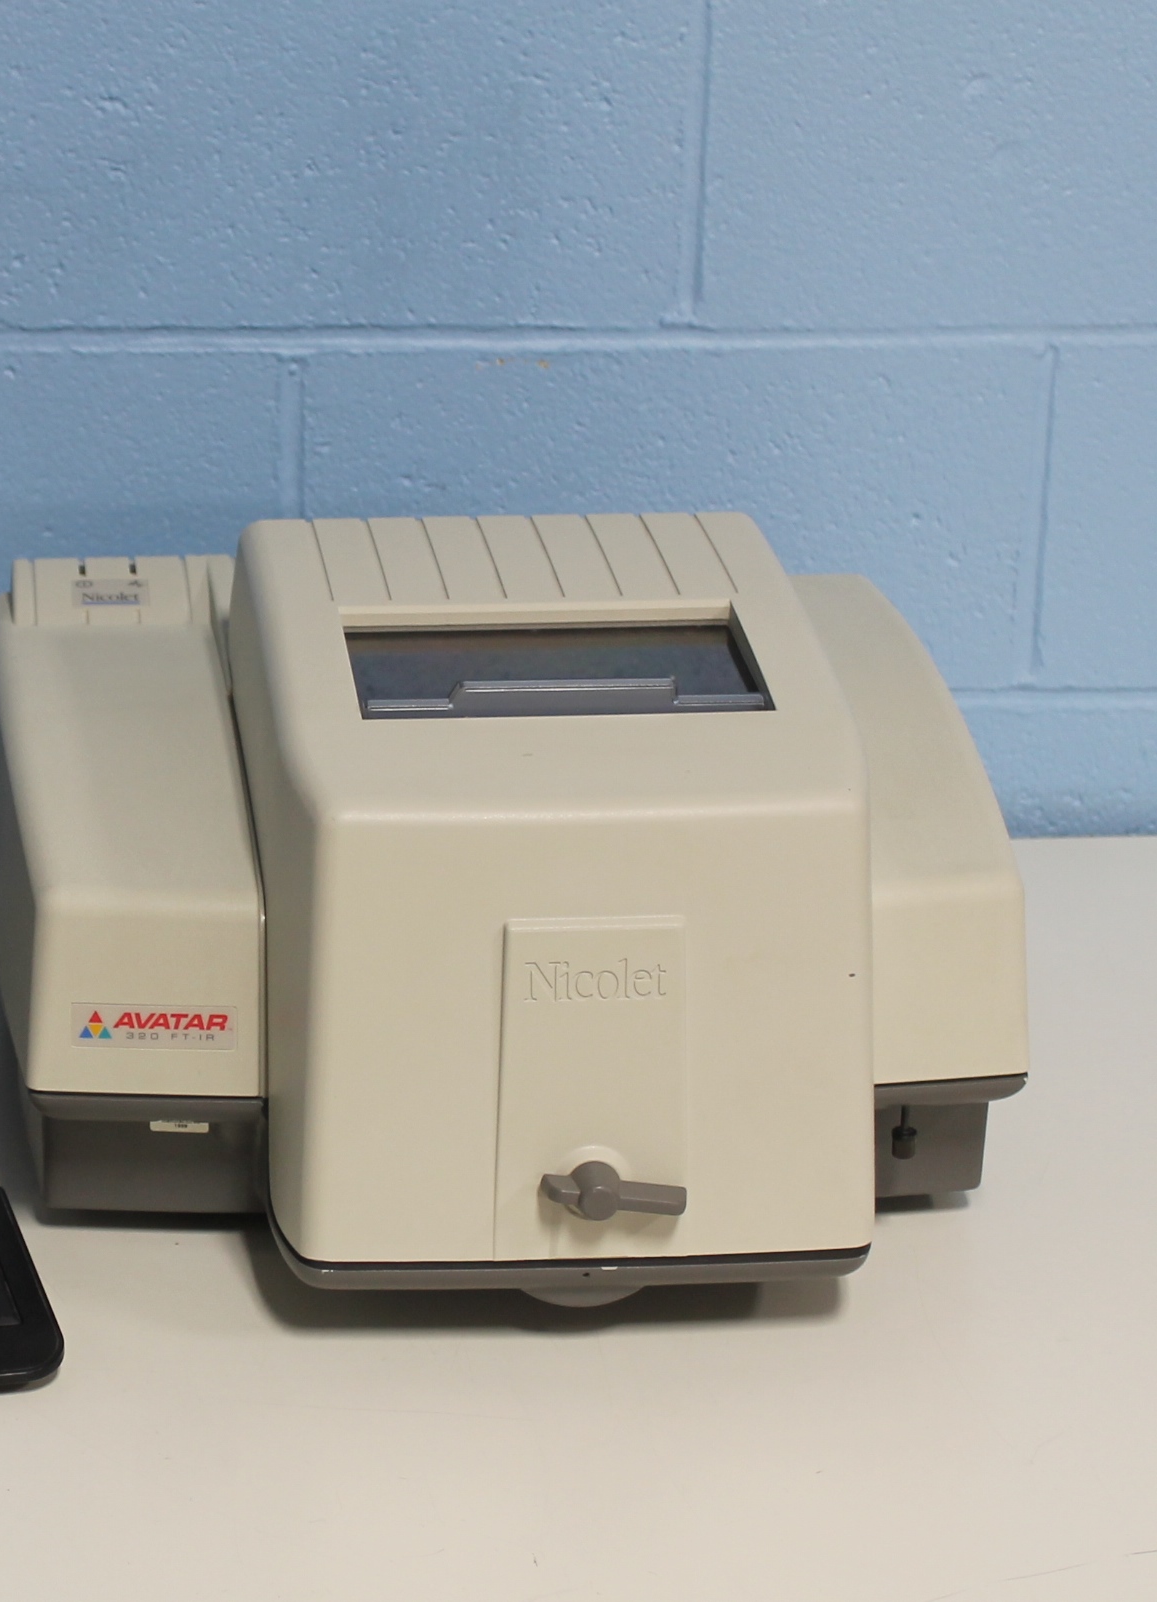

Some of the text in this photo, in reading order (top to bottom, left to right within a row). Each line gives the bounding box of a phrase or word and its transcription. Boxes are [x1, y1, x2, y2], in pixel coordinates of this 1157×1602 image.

[83, 592, 140, 603] Nicolet
[524, 958, 667, 1002] Nicolet
[113, 1012, 228, 1031] AVATAR
[171, 1033, 215, 1041] FT-IR
